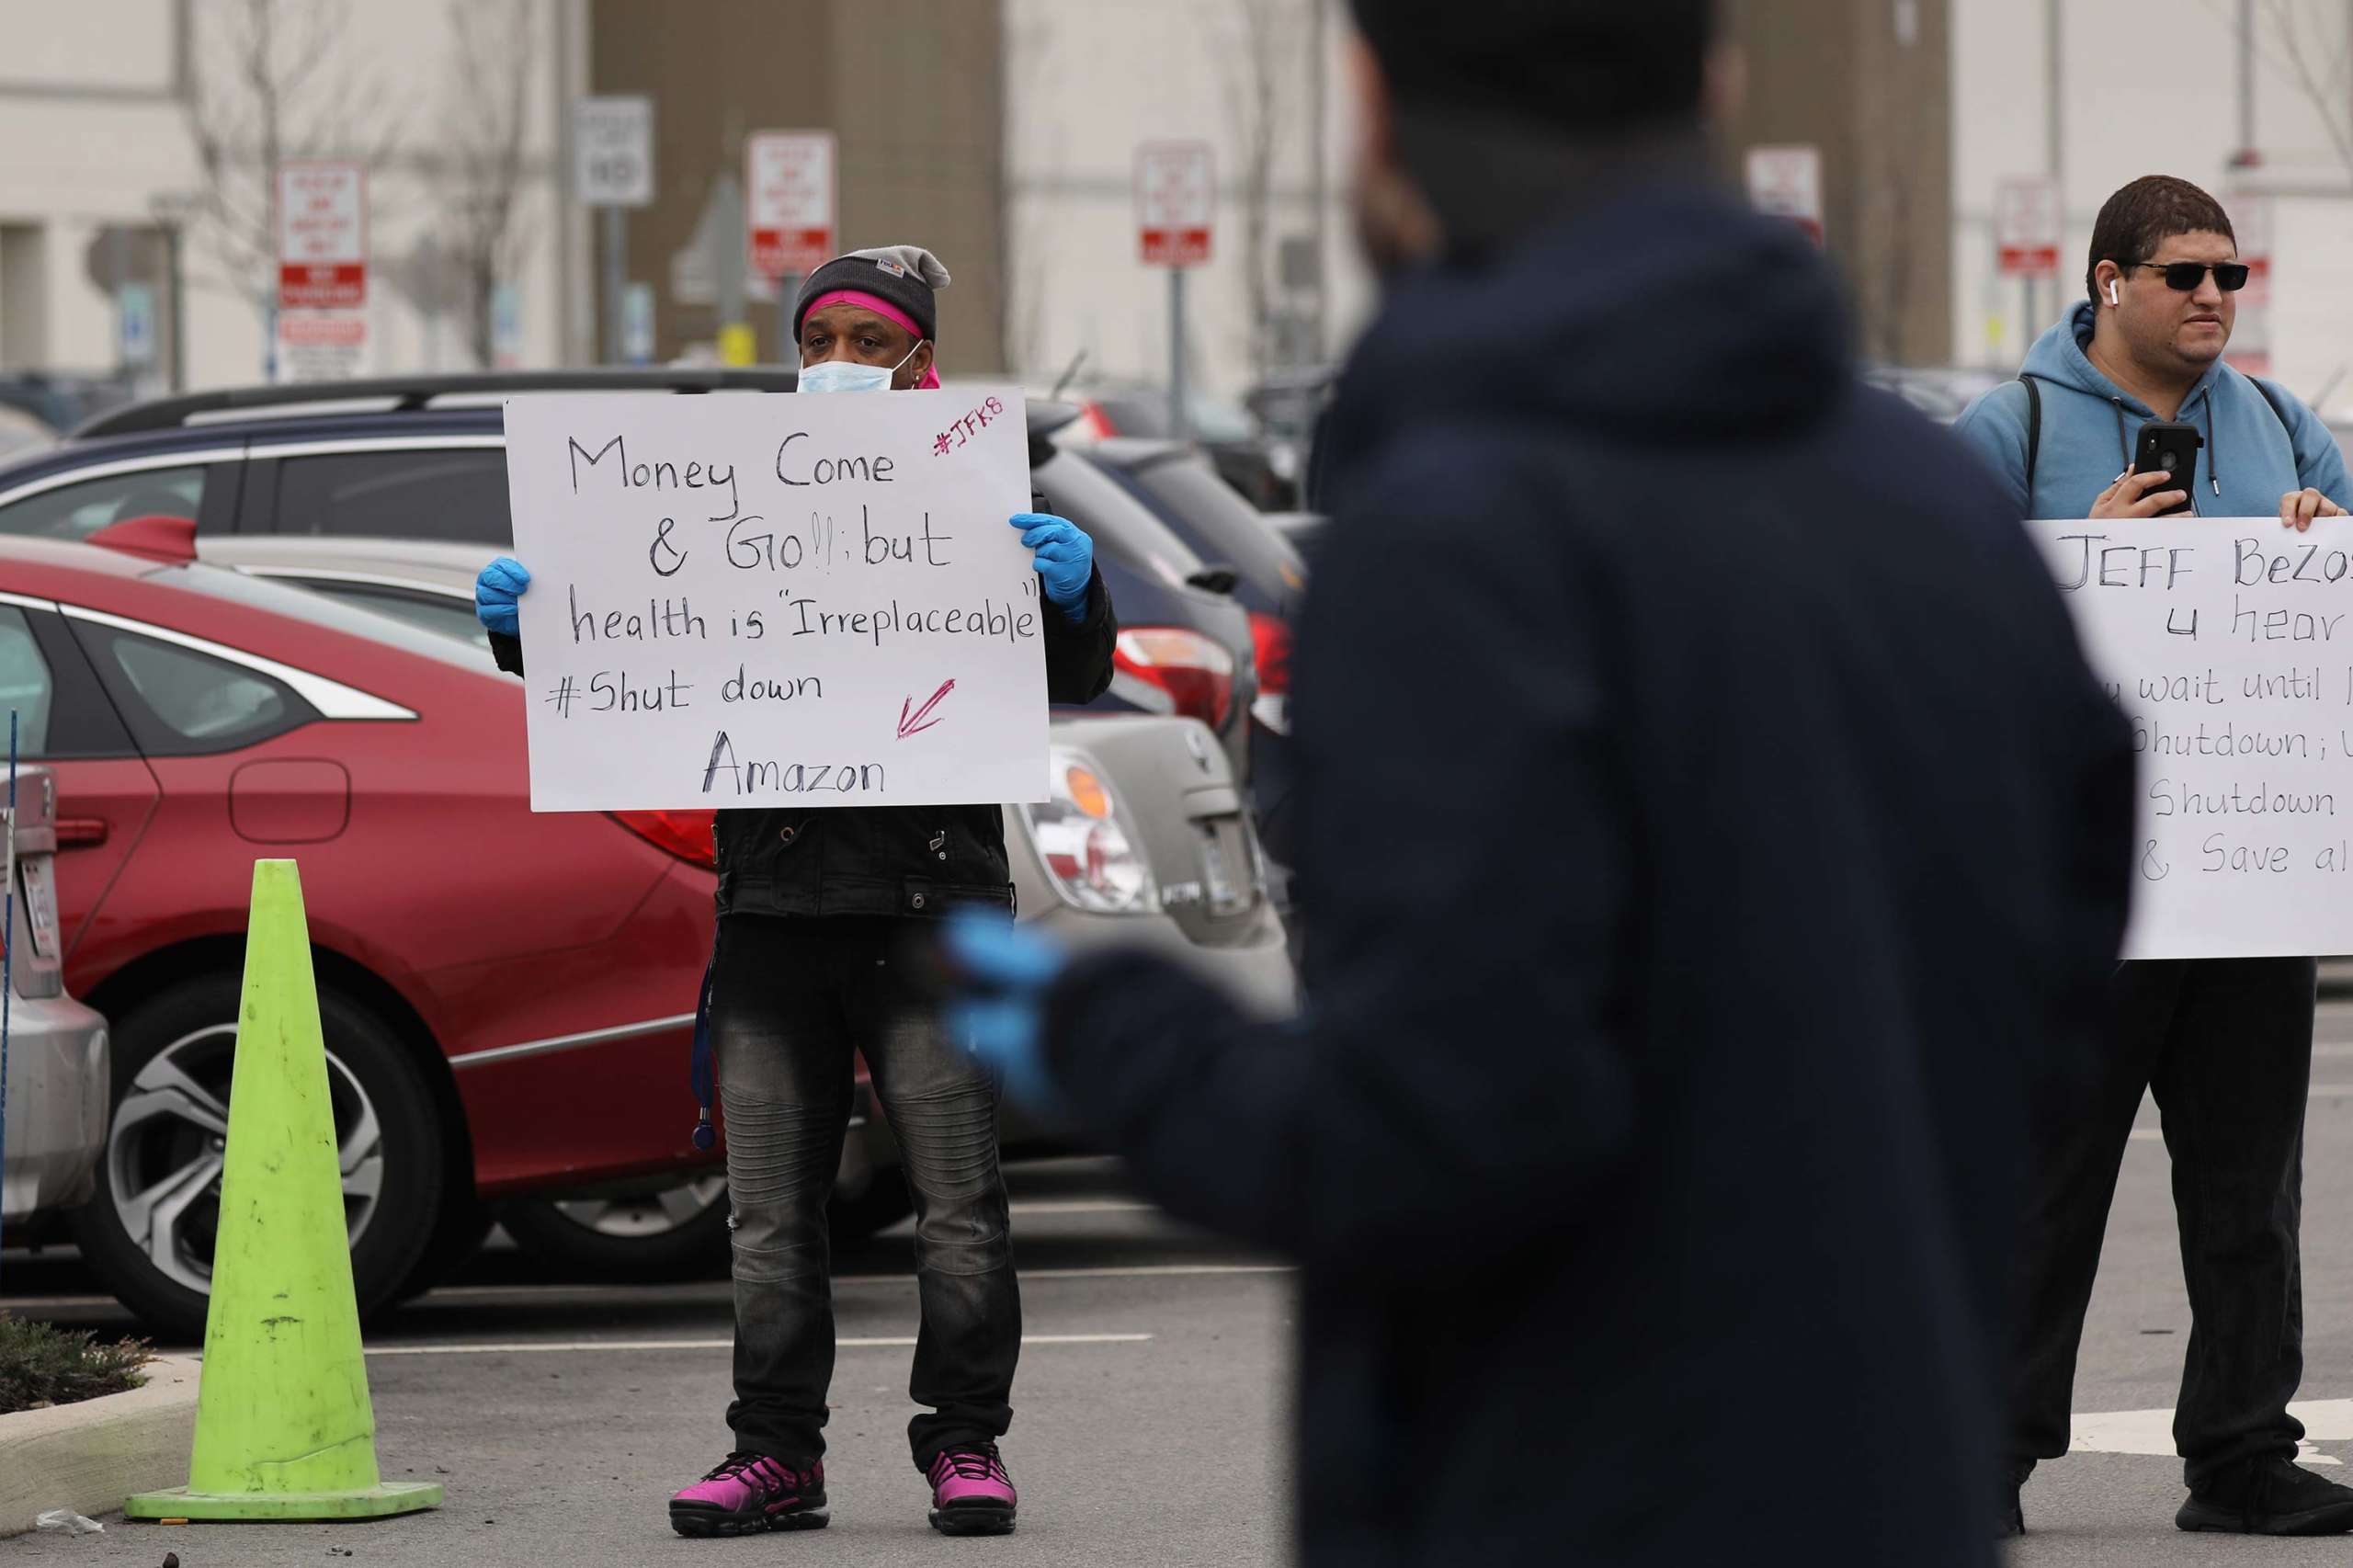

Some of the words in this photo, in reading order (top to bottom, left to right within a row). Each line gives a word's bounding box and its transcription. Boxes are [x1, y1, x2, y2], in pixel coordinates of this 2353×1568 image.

[933, 396, 1004, 457] #JFK8
[568, 435, 738, 521] Money
[776, 432, 894, 486] Come
[649, 517, 688, 577] &
[862, 505, 952, 565] but
[2055, 534, 2195, 593] JEFF
[569, 584, 706, 644] health
[731, 609, 764, 639] is
[2232, 594, 2346, 642] hear
[721, 663, 822, 703] down
[2139, 668, 2223, 705] wait
[2244, 666, 2320, 700] until
[702, 731, 884, 794] Amazon
[2149, 778, 2335, 816] Shutdown
[2141, 838, 2169, 881] &
[2202, 832, 2289, 873] Save
